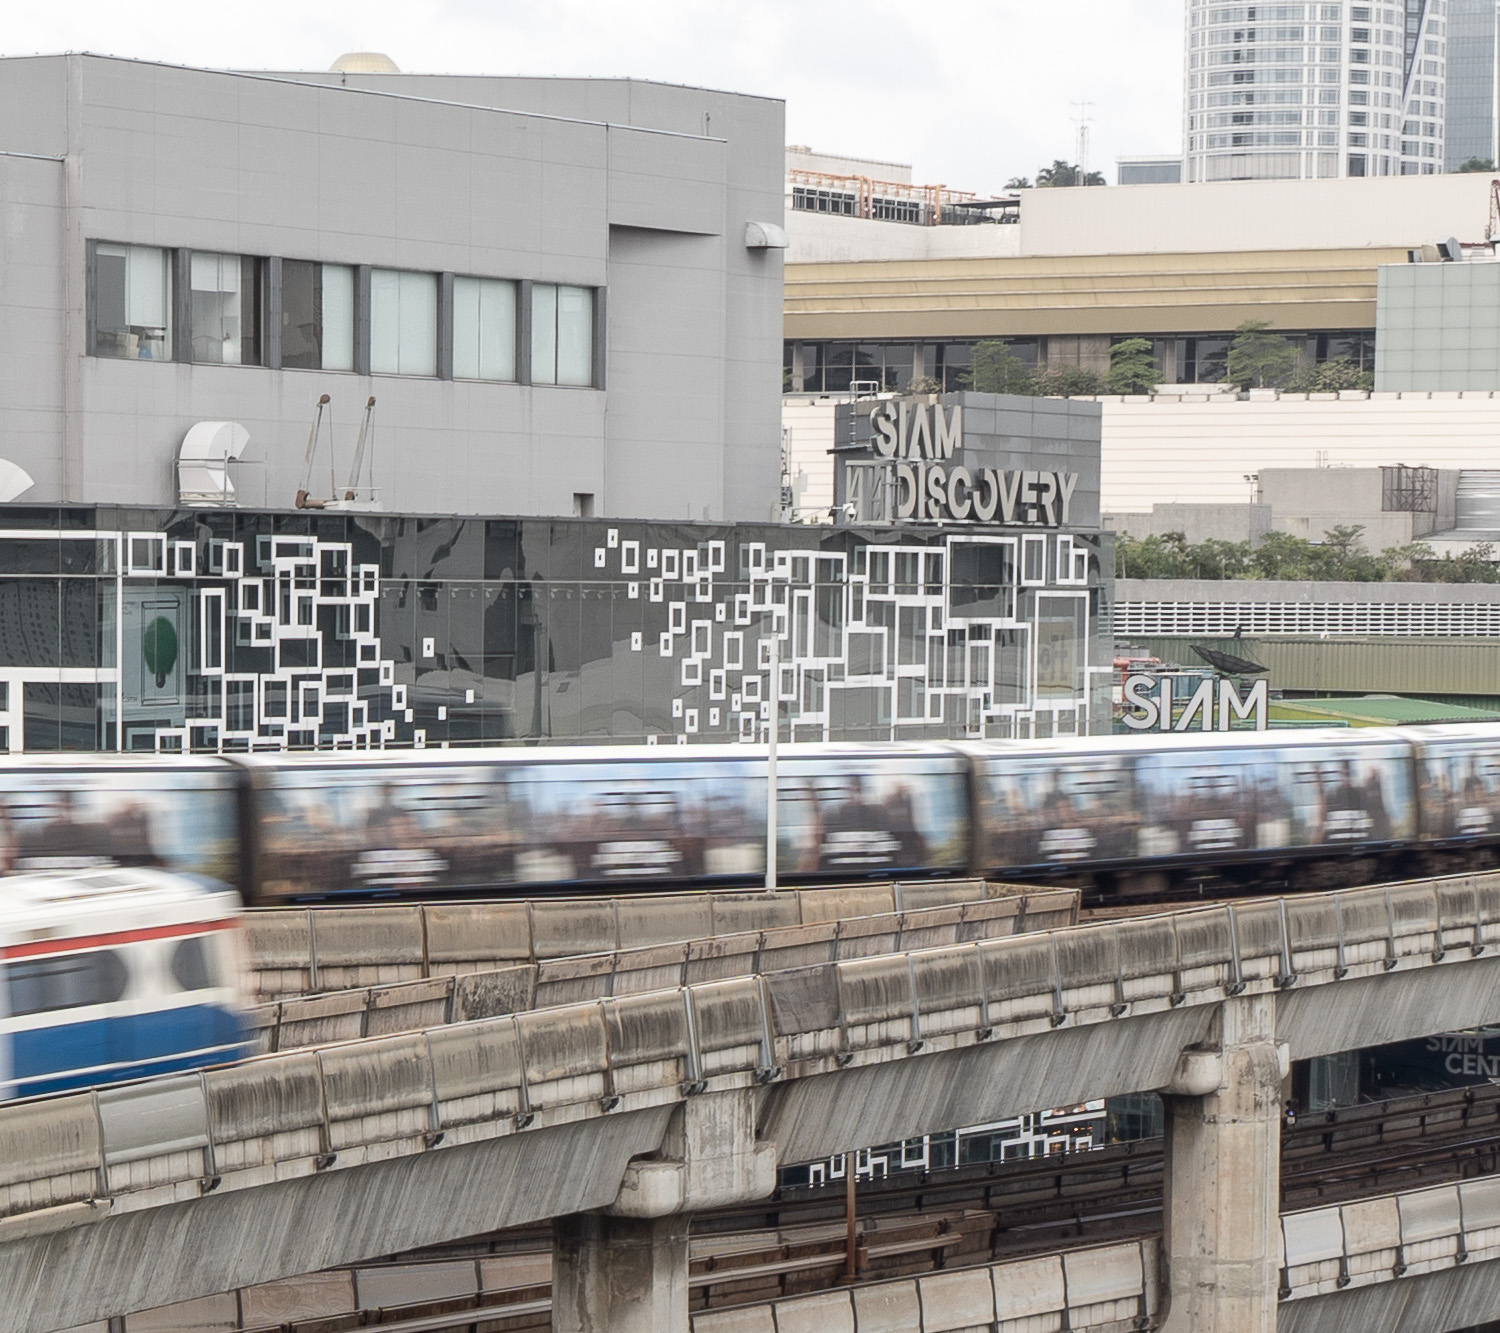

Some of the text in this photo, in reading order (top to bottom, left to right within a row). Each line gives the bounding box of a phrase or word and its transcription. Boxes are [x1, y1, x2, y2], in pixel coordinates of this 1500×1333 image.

[871, 402, 963, 459] SIAM
[893, 464, 1079, 525] DISCOVERY
[1122, 675, 1269, 731] SIAM
